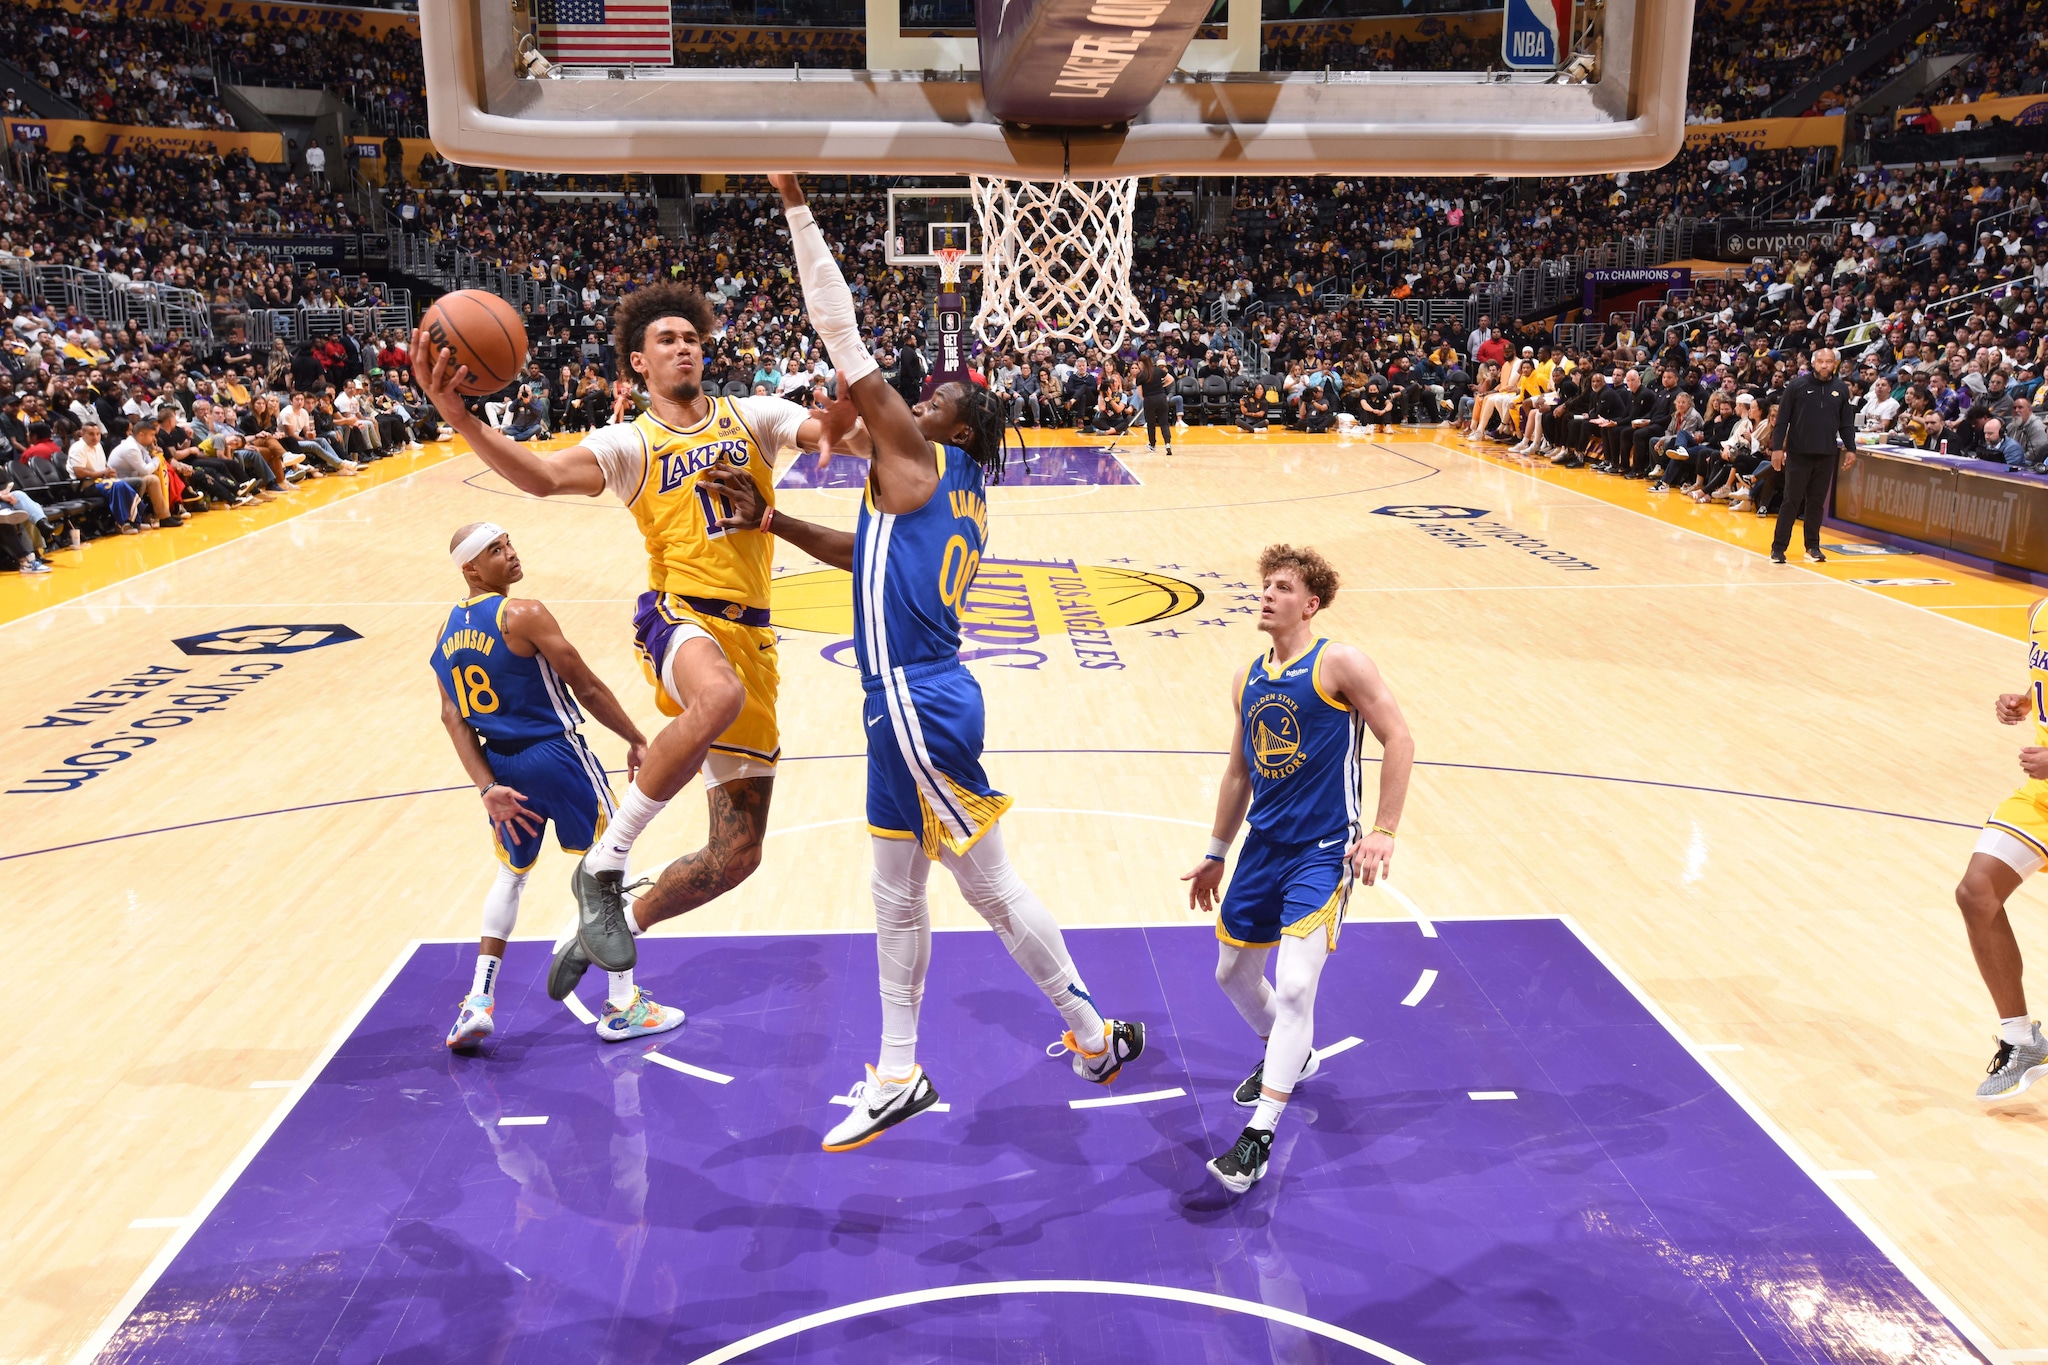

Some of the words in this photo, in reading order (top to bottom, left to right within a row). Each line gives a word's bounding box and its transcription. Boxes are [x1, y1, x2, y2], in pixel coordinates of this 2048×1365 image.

[217, 2, 364, 28] LAKERS
[1268, 23, 1355, 40] KERS
[1513, 31, 1546, 57] NBA
[128, 135, 152, 144] LOS
[1686, 132, 1708, 141] LOS
[283, 246, 334, 255] EXPRESS
[1595, 271, 1610, 280] 17x
[1611, 270, 1669, 280] CHAMPIONS
[943, 334, 958, 346] GET
[944, 347, 959, 359] THE
[944, 360, 960, 372] APP
[718, 426, 741, 437] bibigo
[658, 440, 750, 495] LAKERS
[1863, 474, 1927, 522] IN-SEASON
[1925, 477, 2018, 553] TOURNAMENT
[1410, 522, 1488, 549] ARENA
[1467, 521, 1600, 571] crypto.com
[938, 534, 980, 619] 00
[1048, 575, 1092, 599] LOS
[442, 628, 496, 660] ROBINSON
[1058, 598, 1127, 671] ANGELES
[2028, 640, 2048, 670] LAK
[1286, 667, 1309, 678] Rakuten
[22, 665, 193, 730] ARENA
[451, 664, 500, 719] 18
[1247, 693, 1276, 718] GOLDEN
[1277, 693, 1299, 712] STATE
[3, 662, 284, 794] crypto.com
[1280, 716, 1291, 735] 2
[1253, 751, 1308, 780] WARRIORS
